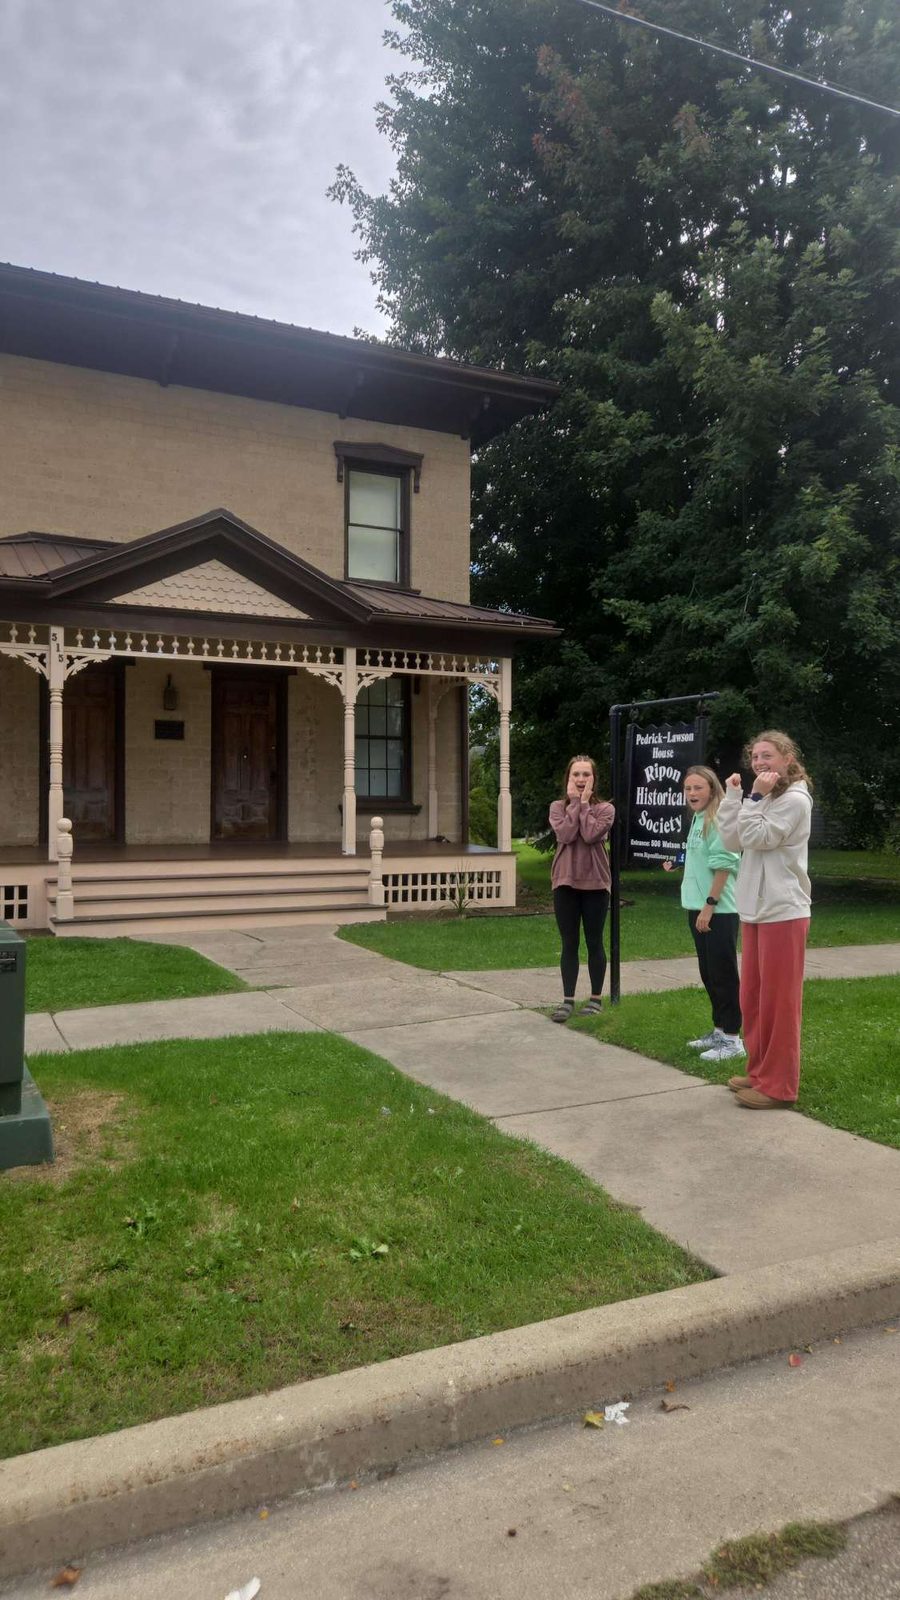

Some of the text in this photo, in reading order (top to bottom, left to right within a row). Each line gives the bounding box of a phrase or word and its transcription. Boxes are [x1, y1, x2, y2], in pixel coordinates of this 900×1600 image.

[635, 731, 695, 745] Pedrick-Lawson
[652, 747, 674, 759] House
[644, 762, 681, 783] Ripon
[635, 786, 687, 806] Historical
[638, 810, 682, 834] Society
[661, 840, 681, 849] Watson
